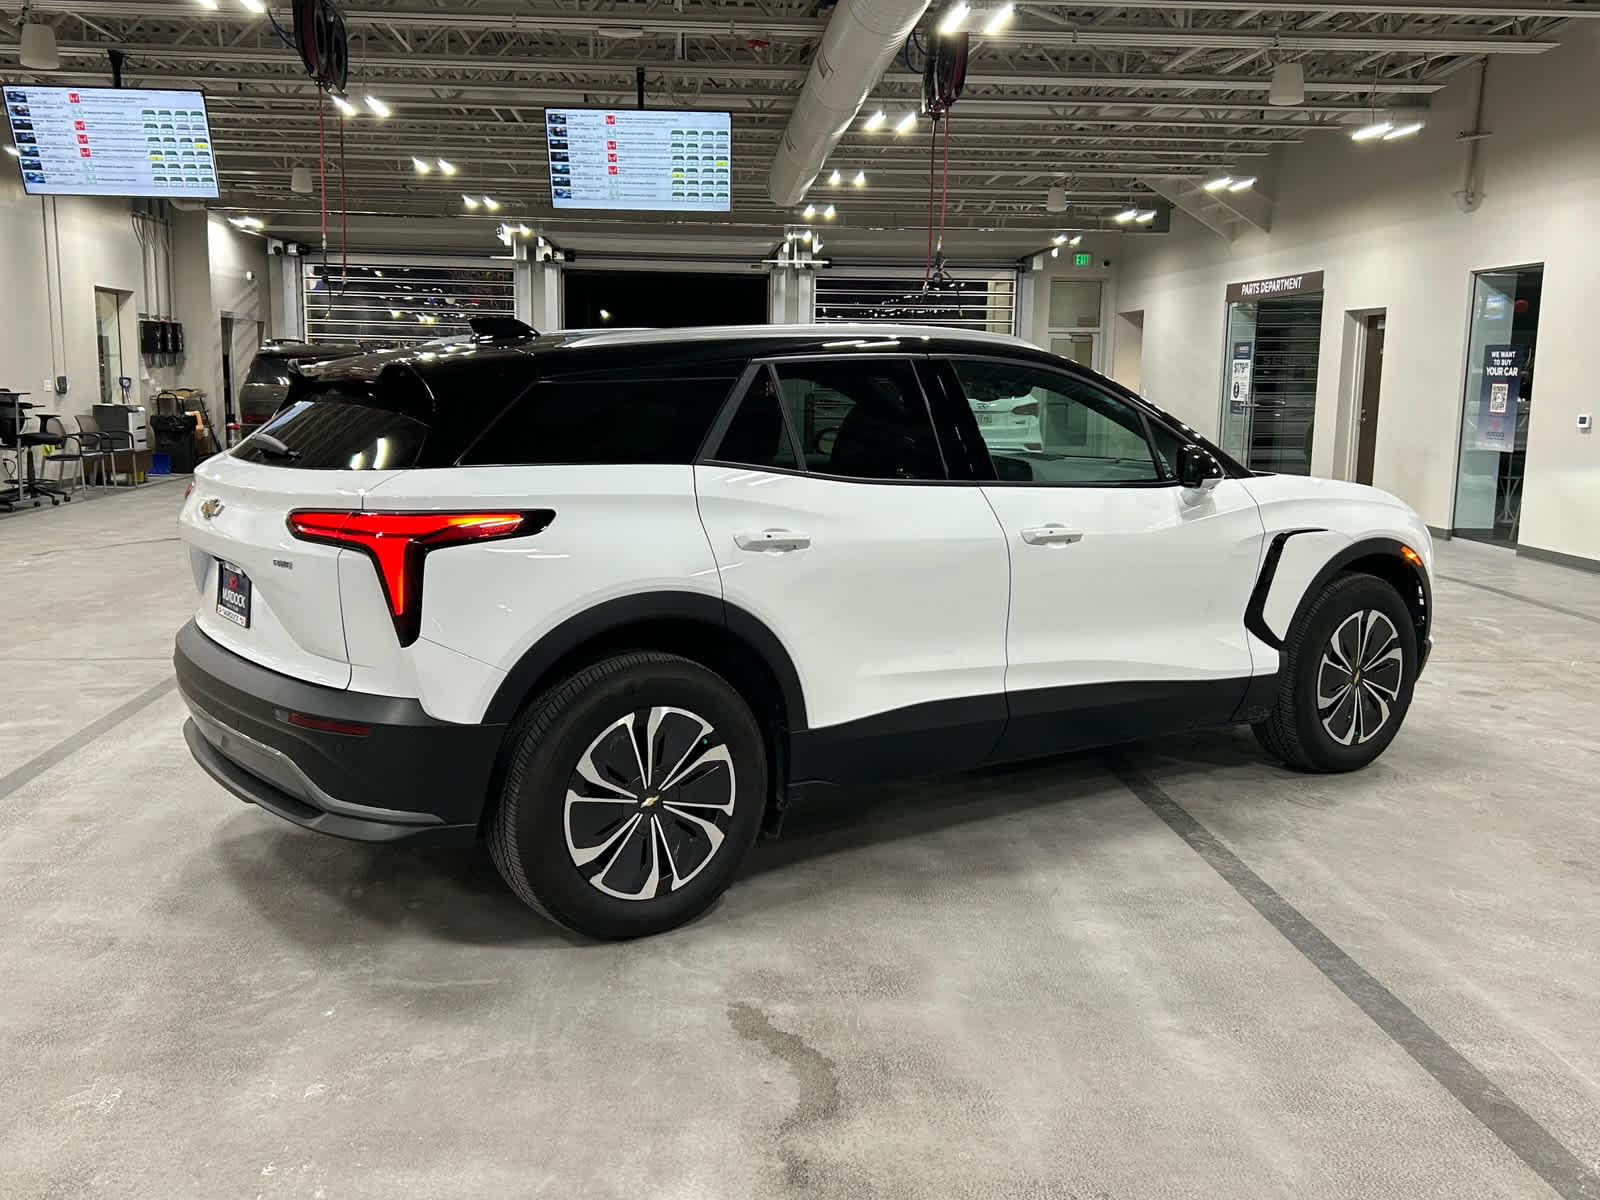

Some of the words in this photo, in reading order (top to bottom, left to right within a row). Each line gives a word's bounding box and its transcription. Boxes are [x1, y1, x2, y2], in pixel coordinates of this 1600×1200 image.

[1241, 282, 1260, 295] PARTS
[1260, 276, 1302, 293] DEPARTMENT
[1486, 367, 1503, 376] YOUR
[1503, 367, 1518, 376] CAR
